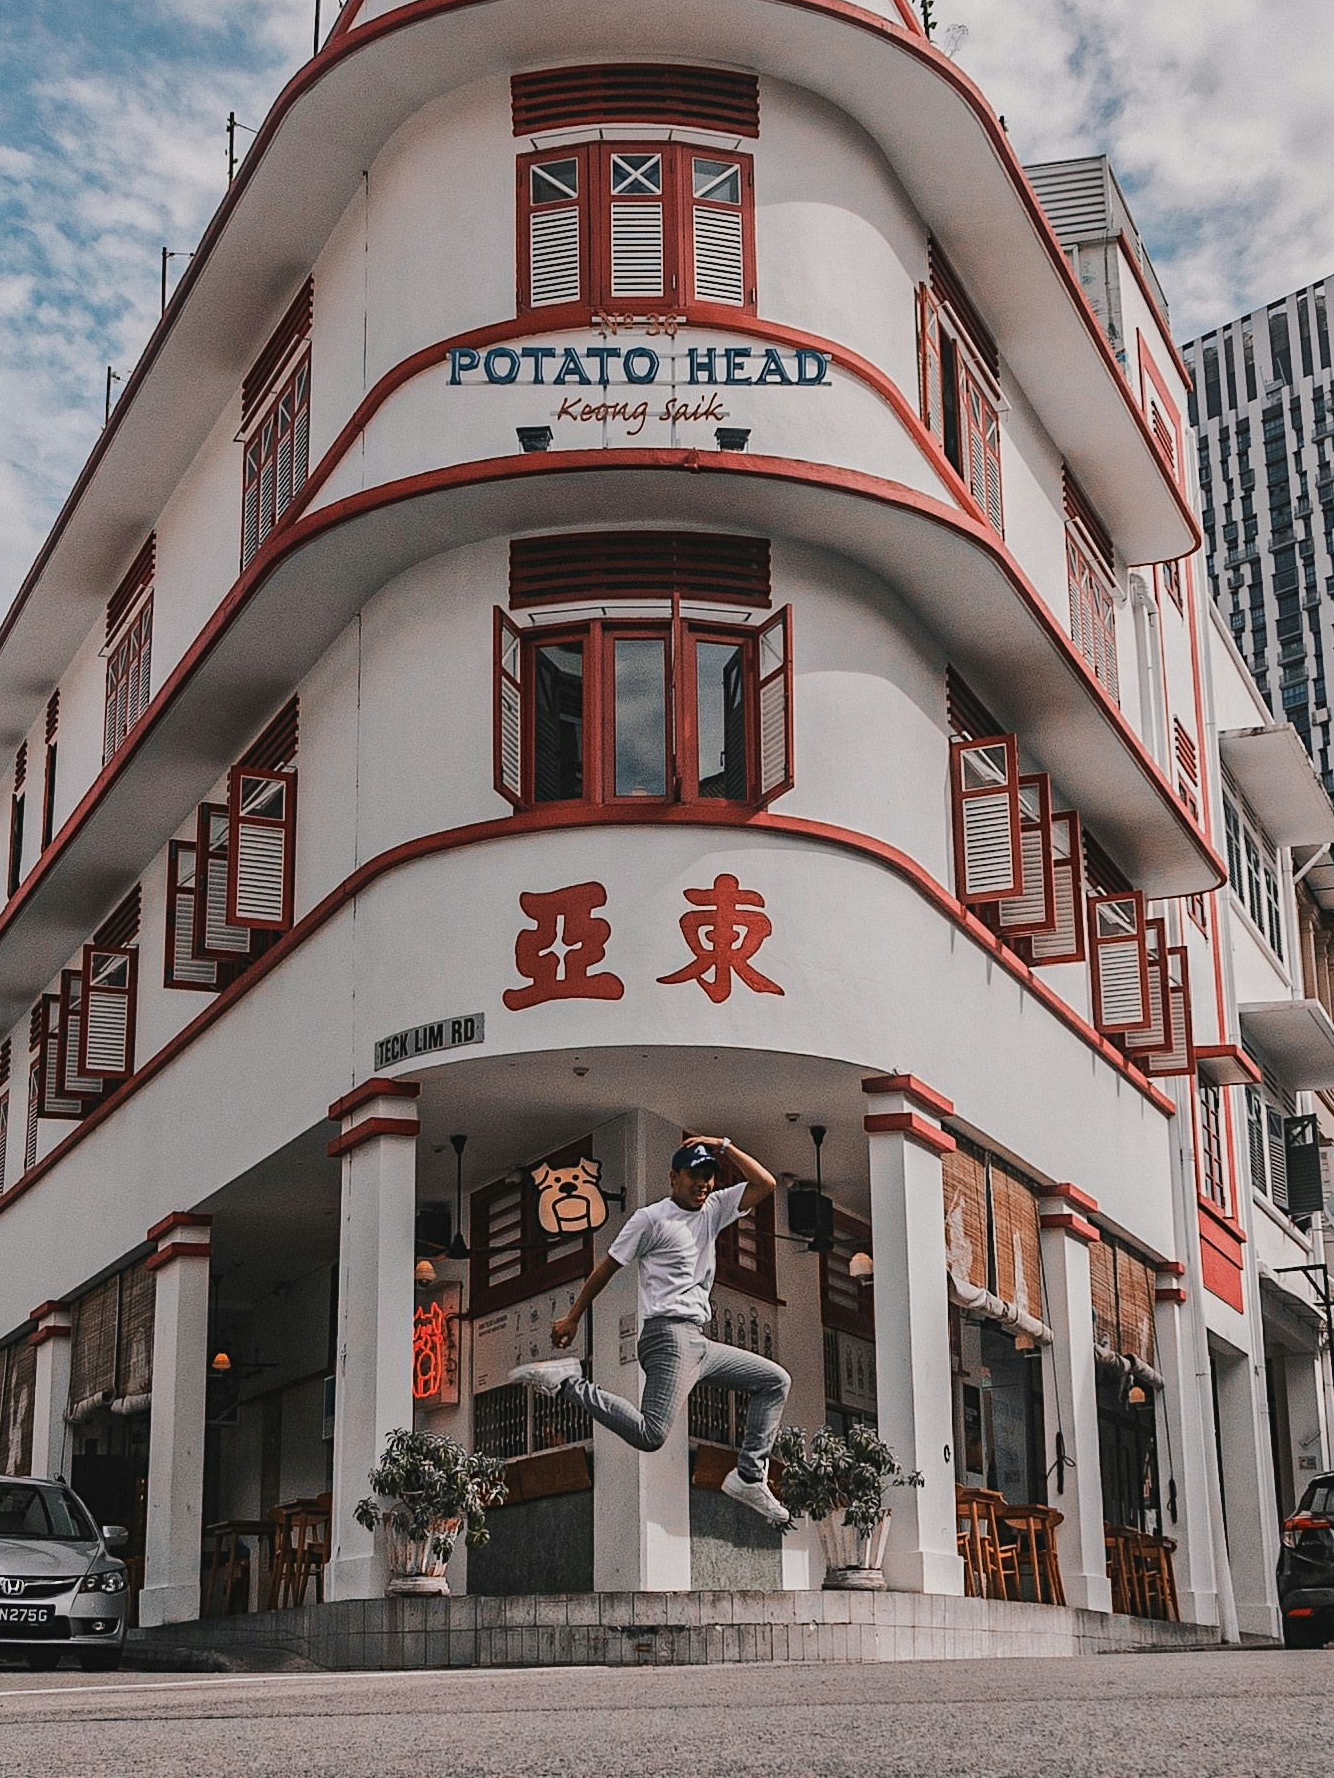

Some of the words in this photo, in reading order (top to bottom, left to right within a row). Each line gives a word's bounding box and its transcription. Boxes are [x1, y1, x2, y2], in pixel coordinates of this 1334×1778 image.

[645, 311, 678, 336] 36
[449, 346, 660, 385] POTATO
[687, 347, 830, 385] HEAD
[557, 396, 649, 435] Keong
[379, 1033, 408, 1065] TECK
[415, 1024, 444, 1053] LIM
[451, 1018, 475, 1044] RD
